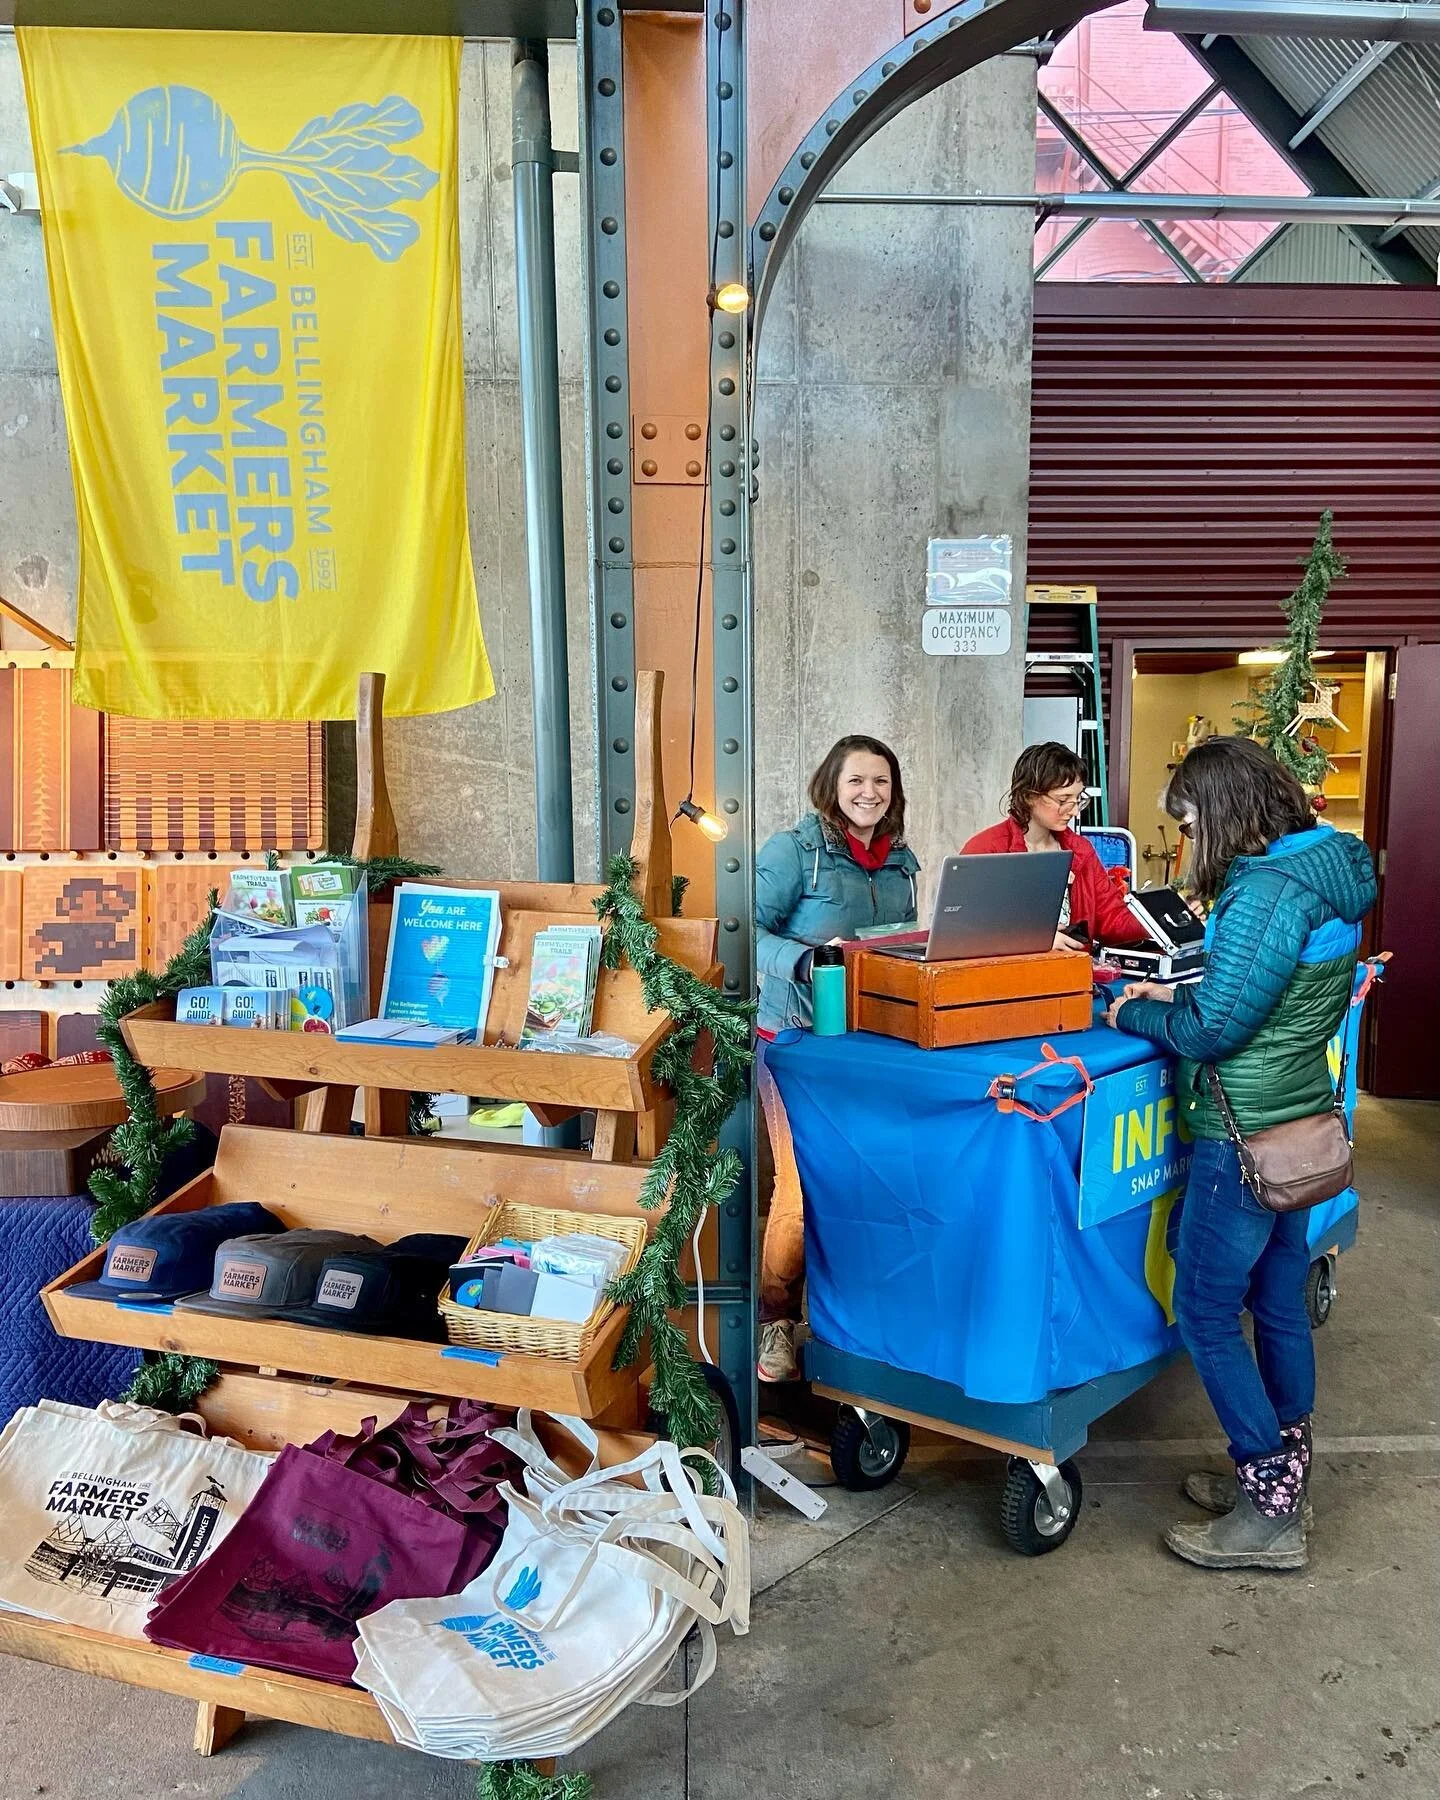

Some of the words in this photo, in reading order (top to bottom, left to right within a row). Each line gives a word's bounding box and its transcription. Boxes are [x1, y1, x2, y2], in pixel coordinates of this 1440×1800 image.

[152, 243, 236, 586] MARKET
[215, 221, 300, 603] FARMERS
[290, 287, 332, 533] BELLINGHAM
[317, 550, 332, 589] 1992
[939, 611, 995, 623] MAXIMUM
[931, 626, 1001, 639] OCCUPANCY
[953, 640, 977, 653] 333
[417, 899, 444, 917] You
[446, 906, 467, 916] ARE
[403, 917, 454, 929] WELCOME
[455, 920, 483, 931] HERE
[190, 996, 210, 1009] GO!
[235, 996, 254, 1009] GO!
[186, 1009, 212, 1020] GUIDE
[232, 1009, 256, 1020] GUIDE
[1131, 1168, 1160, 1196] SNAP
[112, 1256, 150, 1267] FARMERS
[112, 1263, 146, 1274] MARKET
[223, 1271, 260, 1283] FARMERS
[223, 1278, 257, 1290] MARKET
[323, 1281, 357, 1293] FARMERS
[322, 1288, 353, 1299] MARKET
[71, 1472, 137, 1488] BELLINGHAM
[48, 1481, 150, 1507] FARMERS
[45, 1496, 139, 1521] MARKET
[192, 1514, 211, 1548] MARKET
